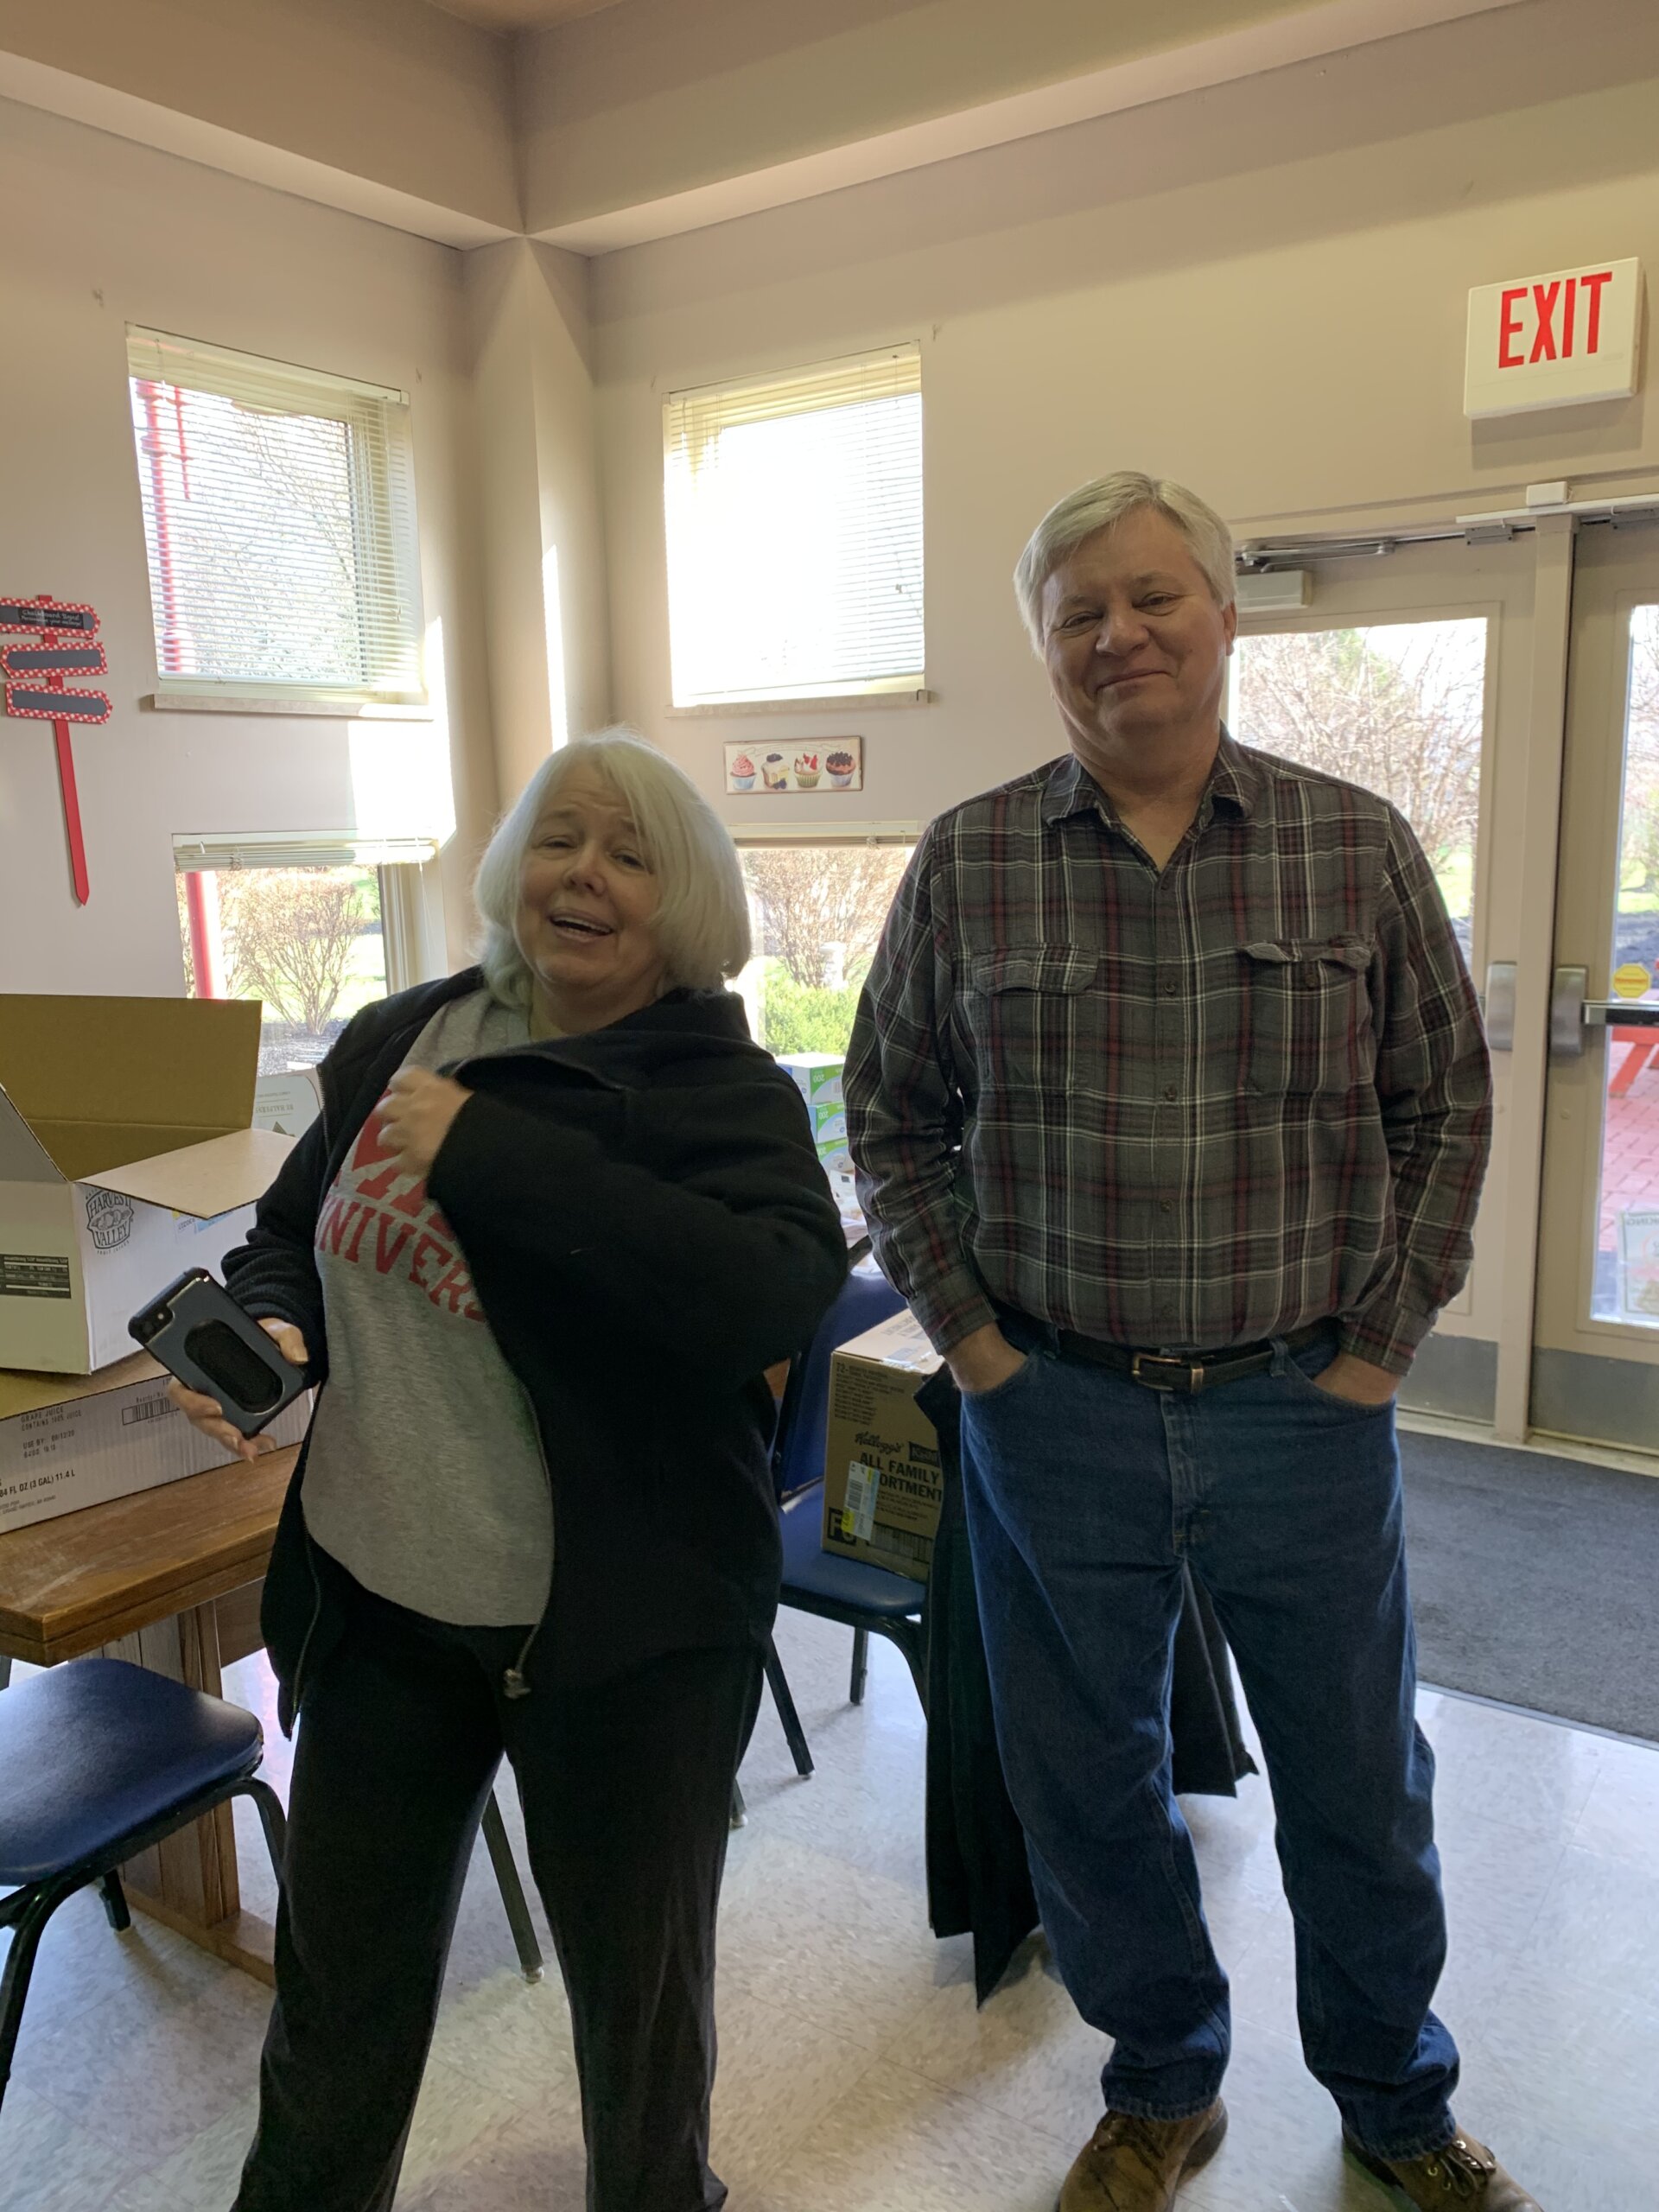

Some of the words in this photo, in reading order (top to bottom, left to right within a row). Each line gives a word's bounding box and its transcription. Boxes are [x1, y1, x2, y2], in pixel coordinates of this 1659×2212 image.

[1498, 271, 1612, 368] EXIT
[89, 1192, 130, 1219] HARVEST
[95, 1220, 128, 1246] VALLEY
[21, 1412, 42, 1423] GRAPE
[46, 1406, 64, 1417] JUICE
[21, 1419, 49, 1432] CONTAINS
[67, 1409, 82, 1420] JUICE
[22, 1440, 35, 1450] USE
[854, 1430, 905, 1455] Kellogg's
[10, 1485, 17, 1495] FL
[19, 1481, 29, 1492] OZ
[29, 1479, 37, 1490] (3
[38, 1474, 54, 1486] GAL)
[55, 1470, 70, 1482] 11.4
[71, 1468, 75, 1477] L
[860, 1452, 883, 1471] ALL
[889, 1460, 940, 1485] FAMILY
[879, 1472, 943, 1503] ORTMENT
